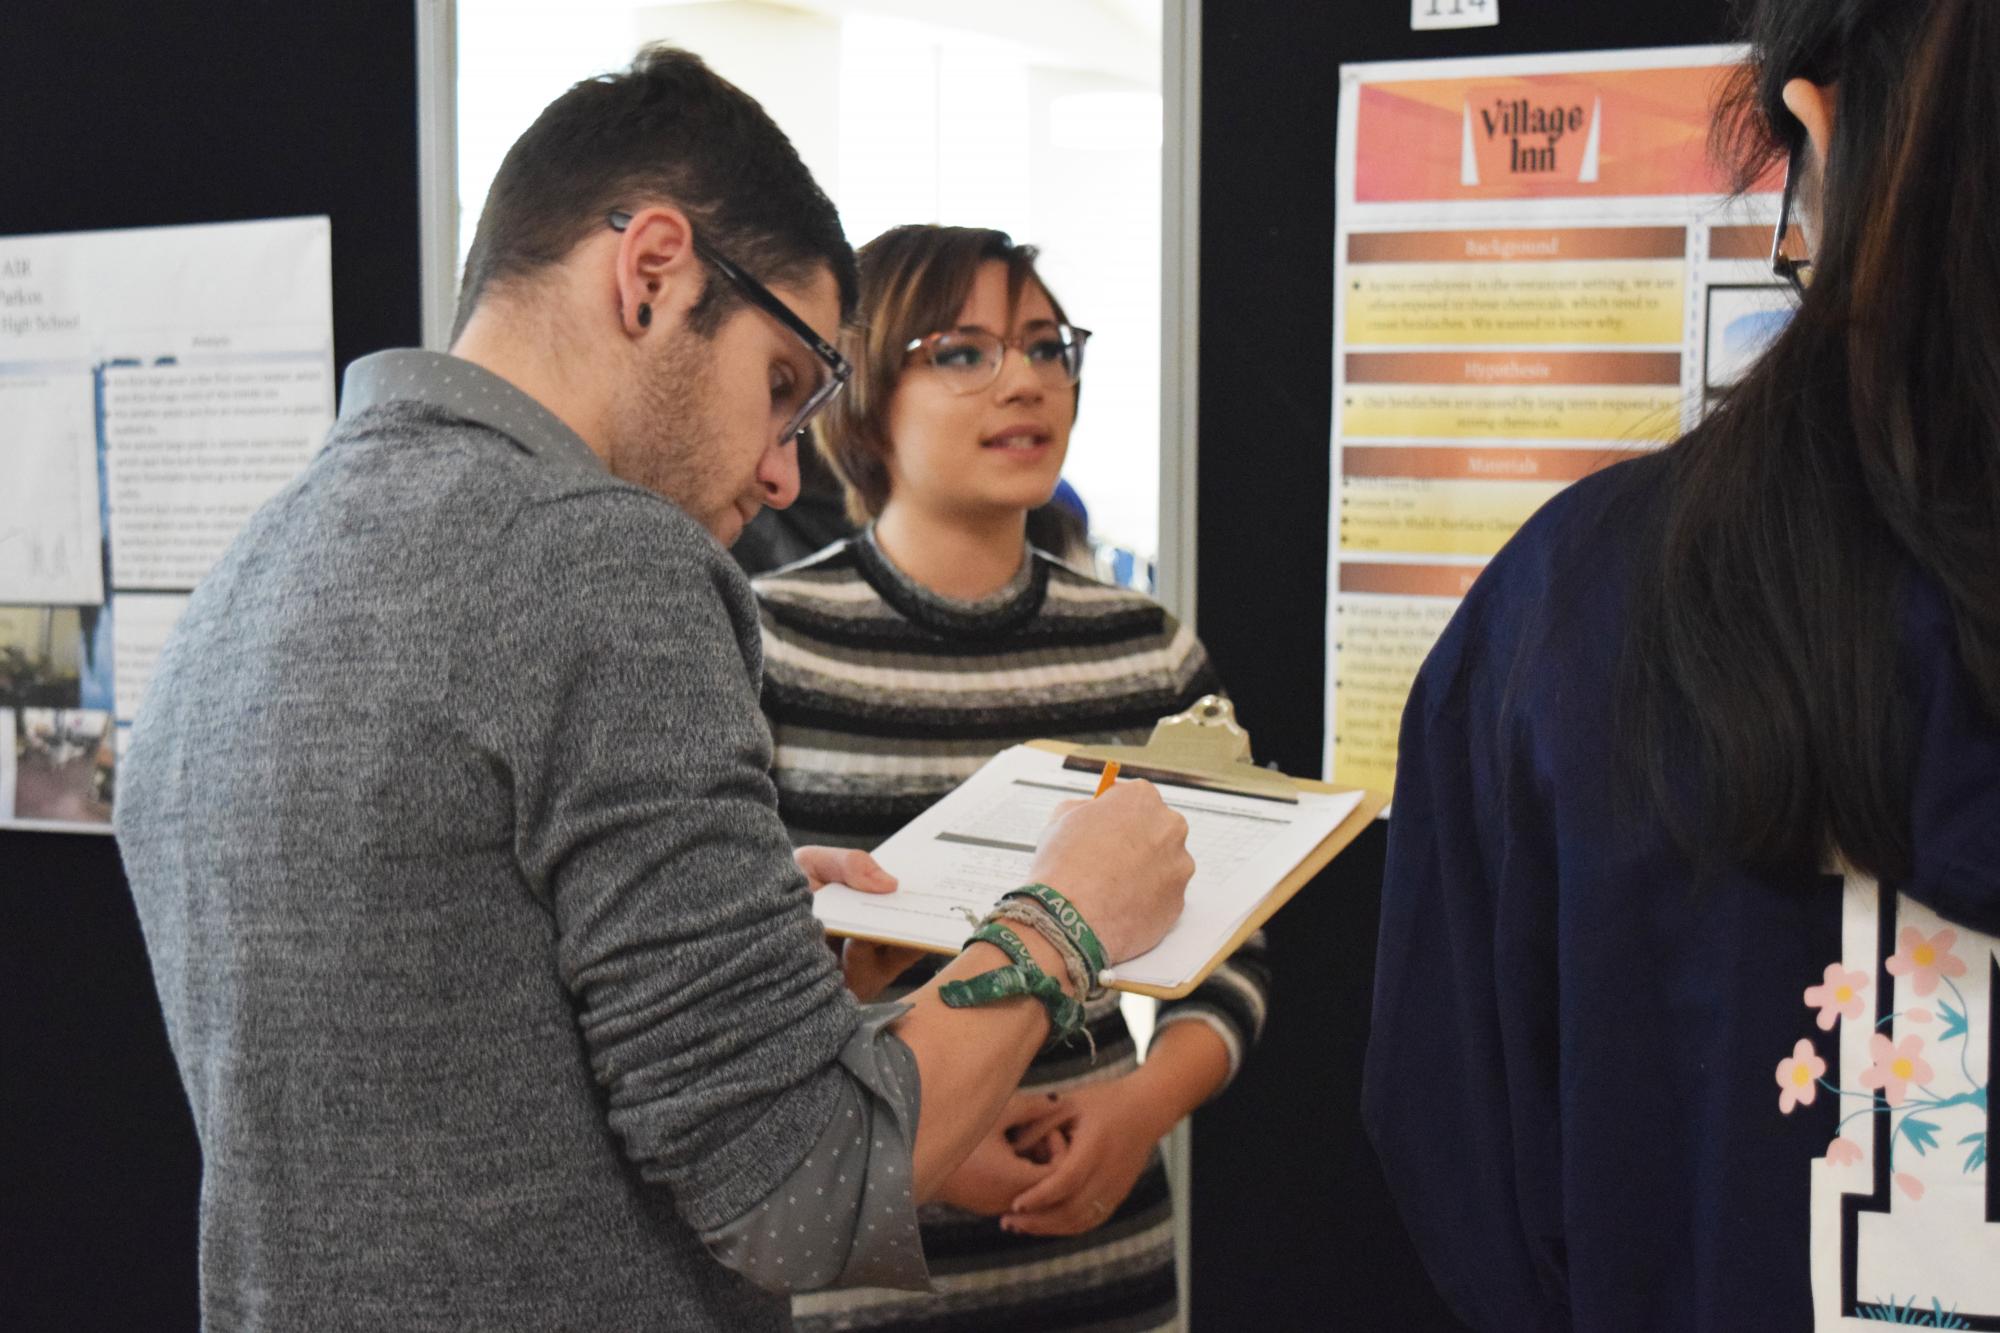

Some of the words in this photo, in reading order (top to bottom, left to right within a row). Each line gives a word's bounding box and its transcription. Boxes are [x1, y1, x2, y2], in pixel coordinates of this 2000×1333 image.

[1481, 98, 1584, 143] Village
[1510, 138, 1556, 173] Inn
[1465, 236, 1559, 260] Background
[2, 258, 32, 279] AIR
[1, 314, 33, 338] High
[35, 312, 80, 332] School
[1464, 360, 1552, 381] Hypothesis
[1468, 456, 1538, 474] Materials
[1036, 887, 1088, 942] LAOS
[1000, 929, 1037, 971] GIVE
